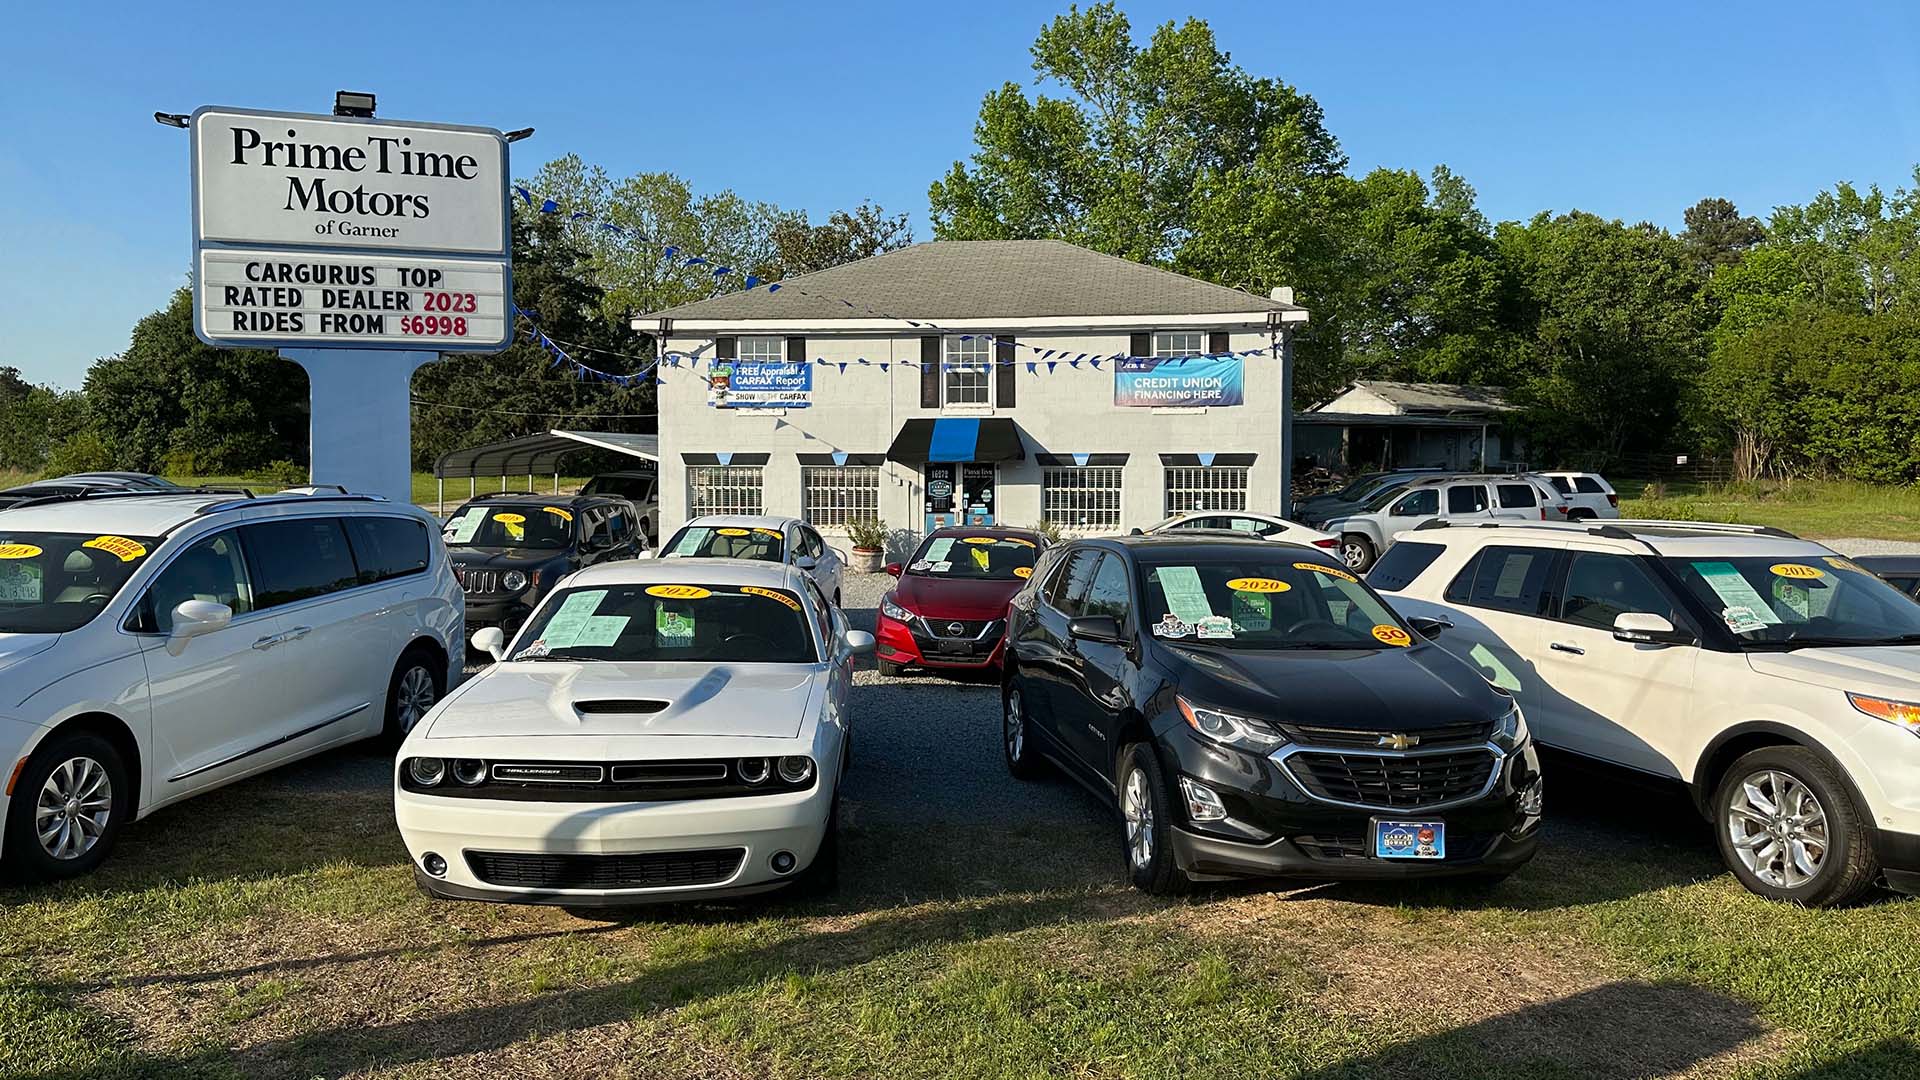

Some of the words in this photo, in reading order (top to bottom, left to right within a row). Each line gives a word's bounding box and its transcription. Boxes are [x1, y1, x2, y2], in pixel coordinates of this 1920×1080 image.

[230, 127, 366, 172] Prime
[367, 136, 478, 180] Time
[284, 175, 430, 219] Motors
[315, 220, 336, 236] of
[338, 220, 399, 238] Garner
[245, 262, 375, 286] CARGURUS
[397, 267, 442, 288] TOP
[224, 285, 302, 308] RATED
[322, 289, 410, 311] DEALER
[423, 292, 477, 313] 2023
[233, 311, 303, 332] RIDES
[320, 313, 384, 334] FROM
[401, 315, 467, 337] $6998
[736, 367, 759, 376] FREE
[735, 376, 772, 385] CARFAX
[776, 376, 806, 386] Report
[1134, 378, 1178, 388] CREDIT
[1182, 377, 1222, 388] UNION
[1134, 390, 1191, 399] FINANCING
[1193, 390, 1222, 399] HERE
[94, 541, 132, 557] LEATHER
[107, 536, 142, 551] LOADED
[1782, 566, 1816, 577] 2015
[656, 586, 699, 597] 2021
[1240, 581, 1280, 590] 2020
[765, 589, 796, 608] POWER
[1376, 629, 1406, 640] 30
